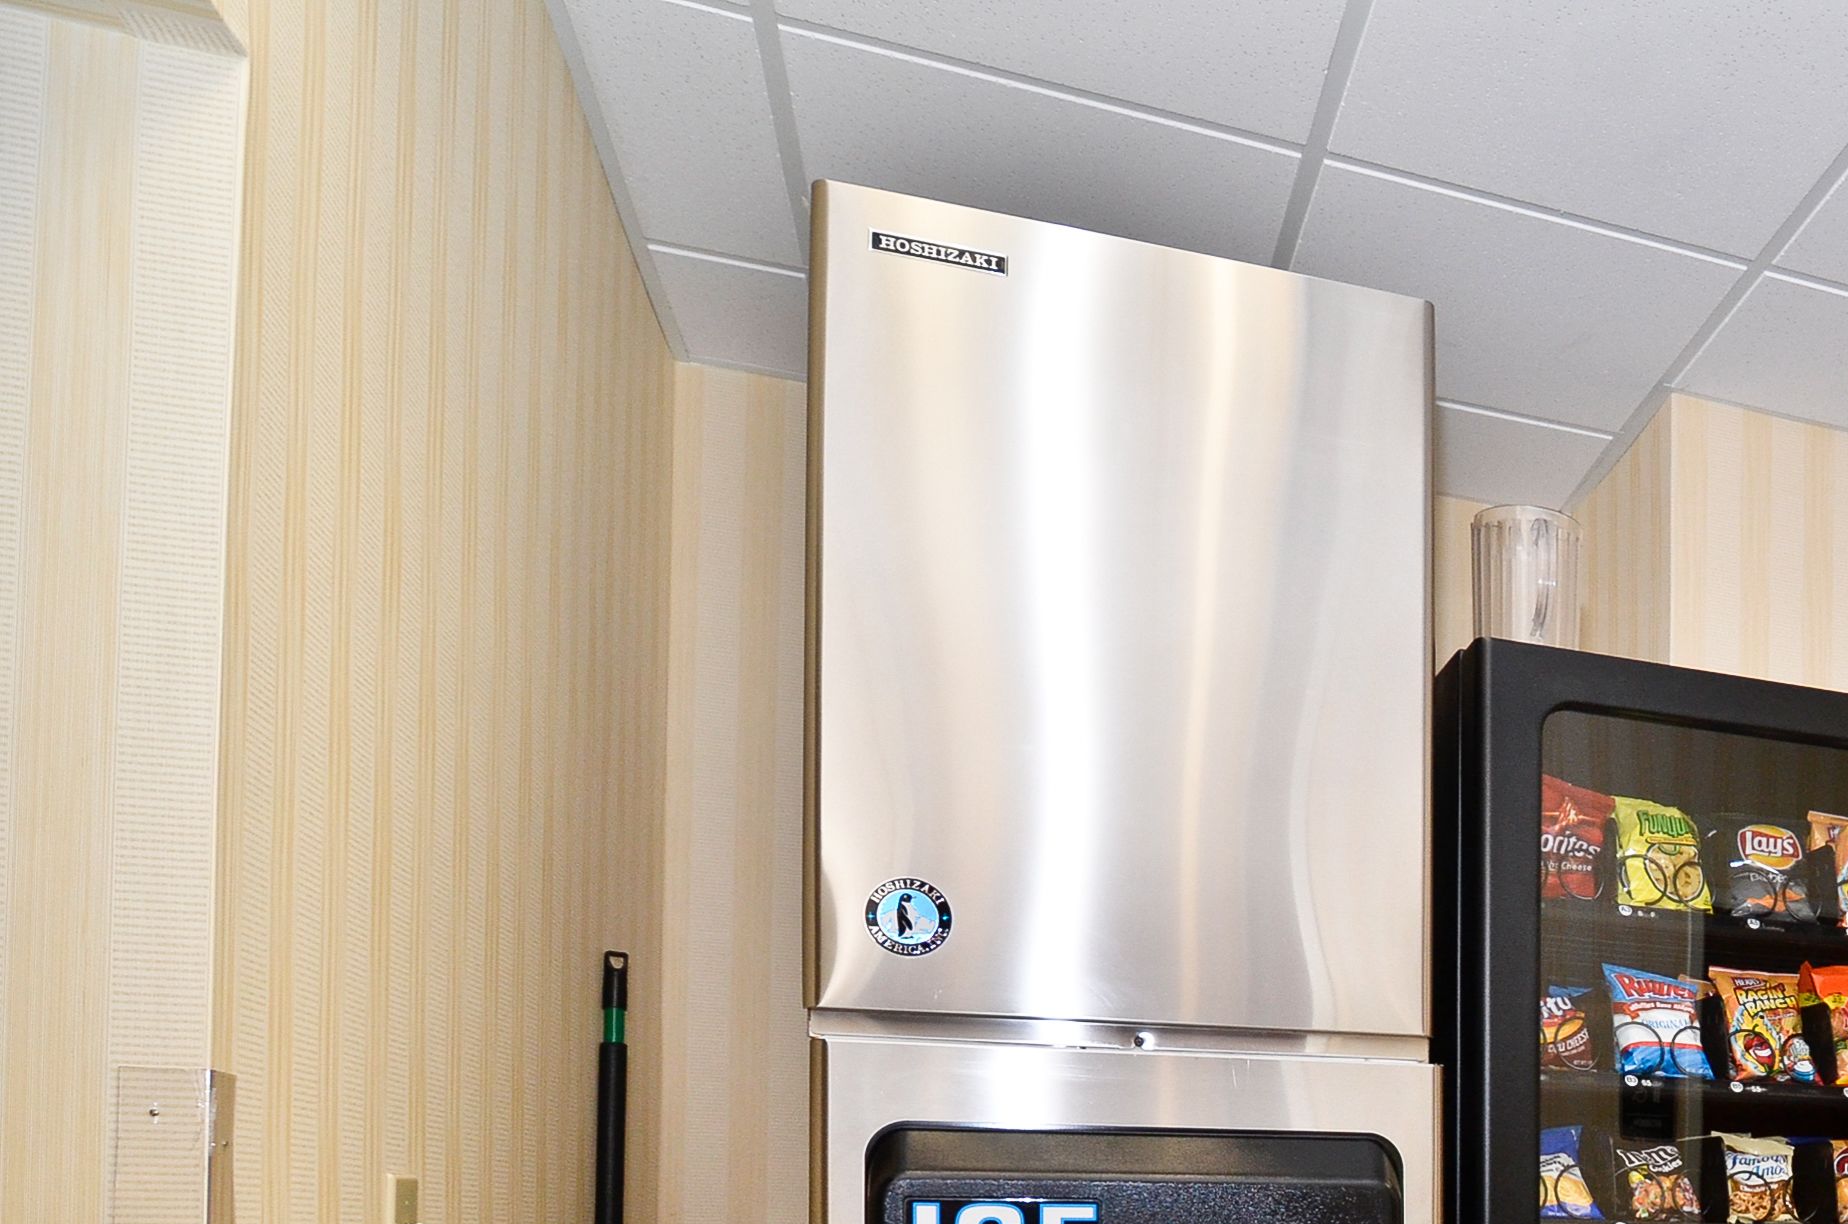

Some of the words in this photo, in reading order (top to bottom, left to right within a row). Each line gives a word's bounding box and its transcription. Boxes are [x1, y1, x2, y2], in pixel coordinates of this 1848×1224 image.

[878, 234, 999, 270] HOSHIZAKI
[1541, 831, 1601, 859] oritos
[1745, 830, 1794, 857] Lay's
[869, 879, 945, 905] HOSHIZAKI
[1736, 986, 1785, 1005] RAGIN'
[1745, 997, 1799, 1016] RANCH
